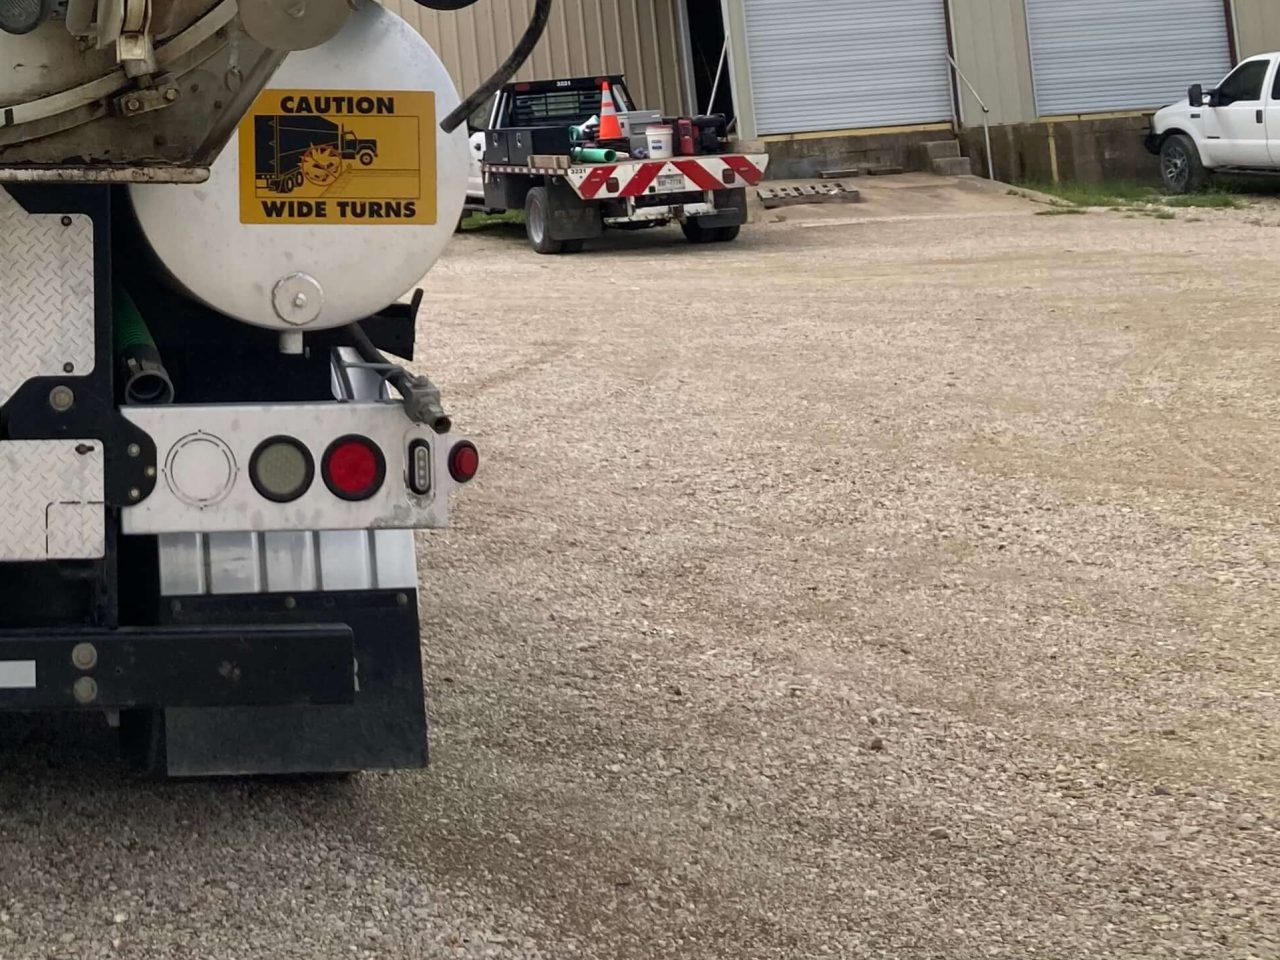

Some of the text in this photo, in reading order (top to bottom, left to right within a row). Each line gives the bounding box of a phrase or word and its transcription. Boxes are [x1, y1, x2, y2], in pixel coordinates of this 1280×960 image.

[280, 96, 395, 114] CAUTION
[261, 200, 416, 218] WIDE TURNS
